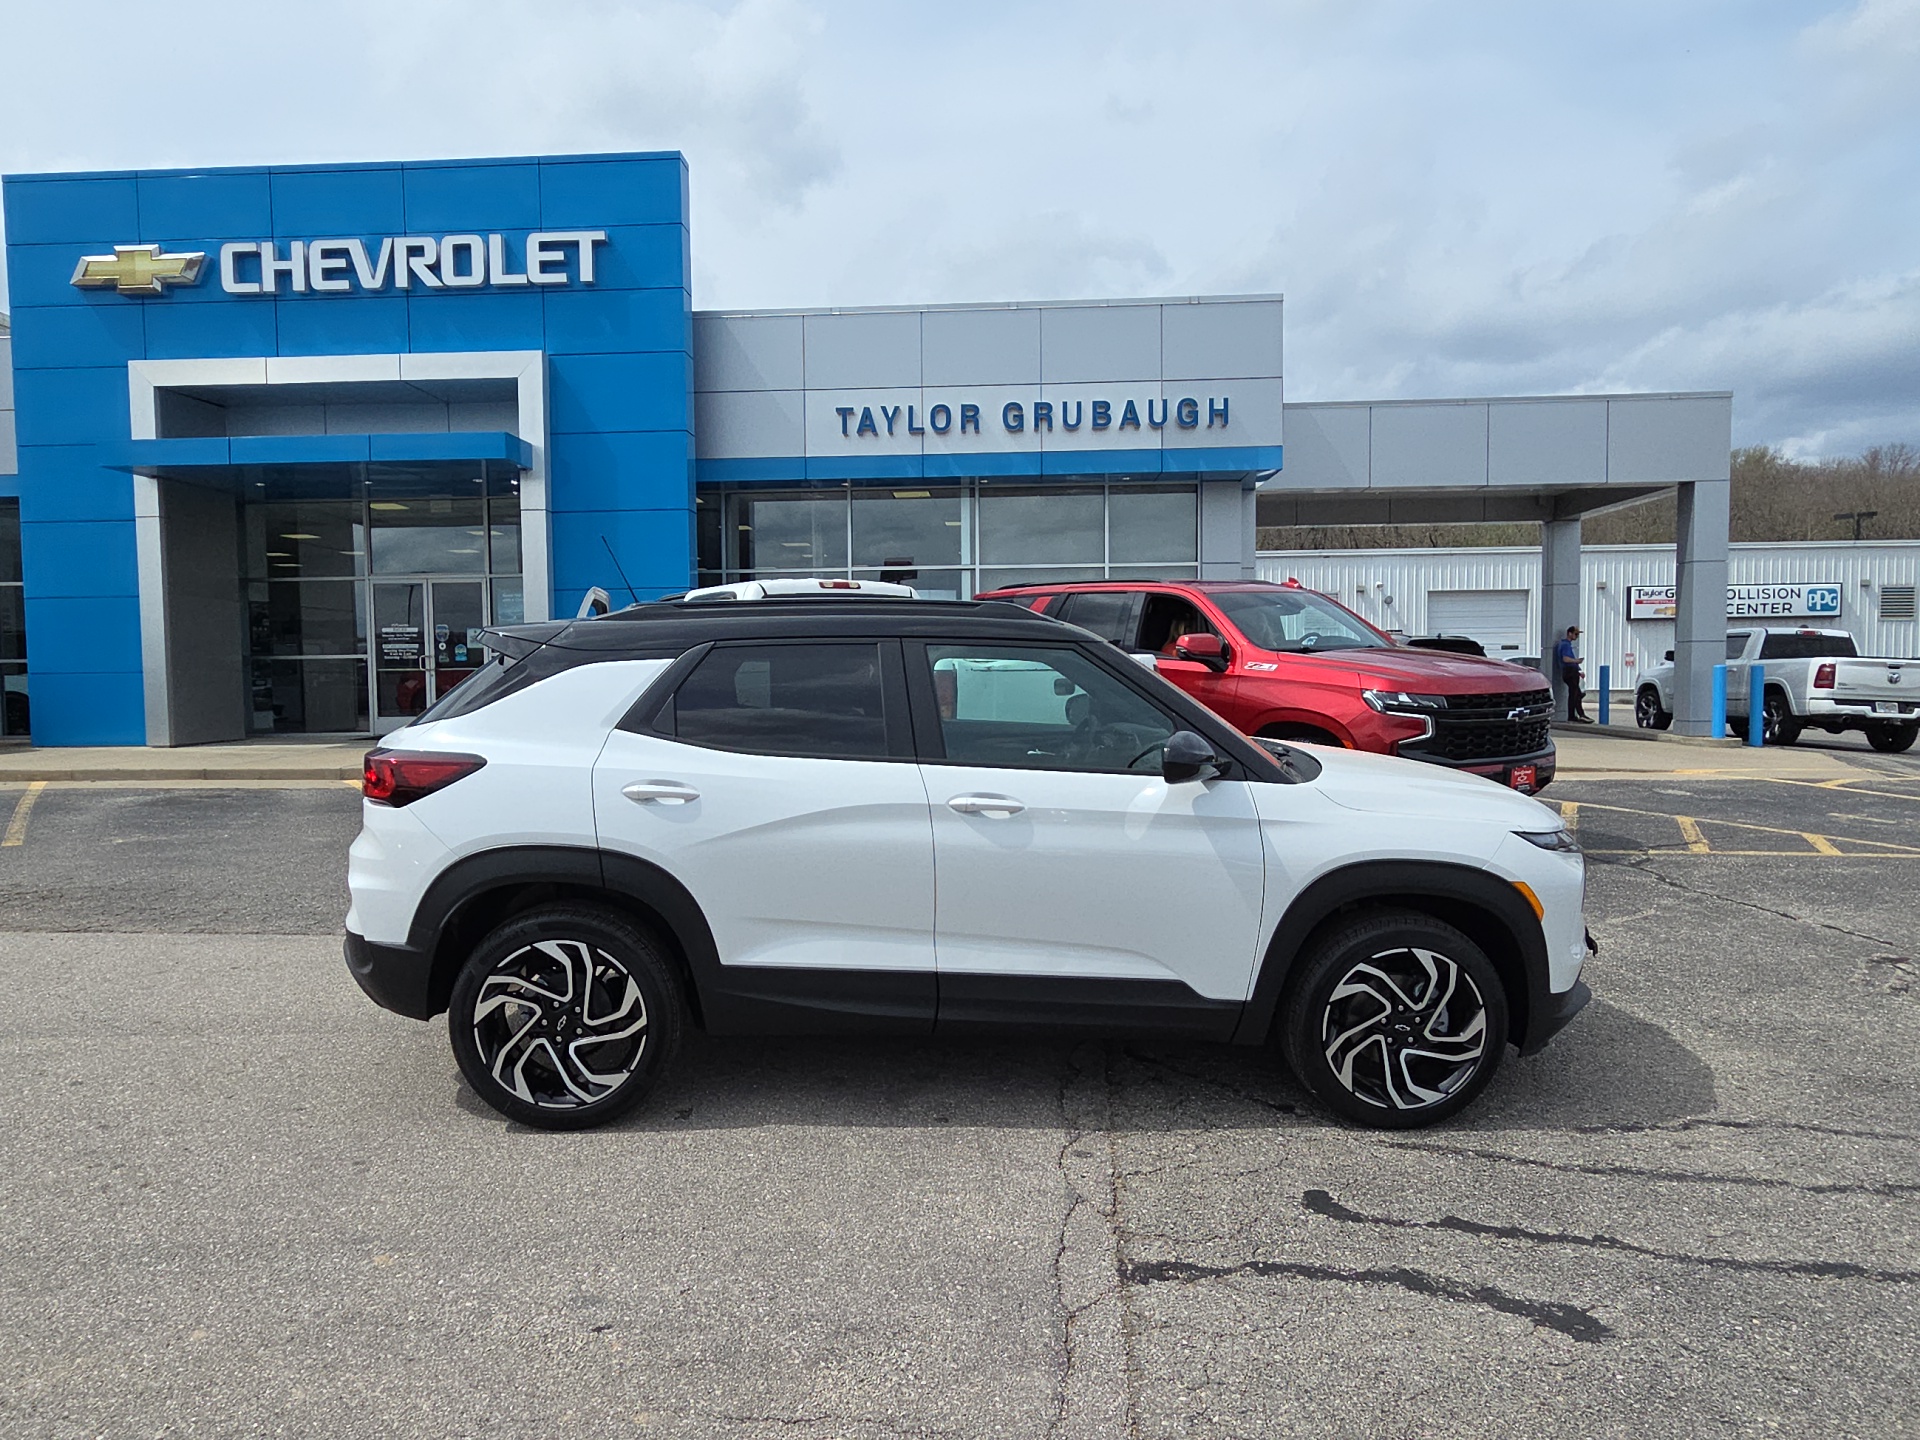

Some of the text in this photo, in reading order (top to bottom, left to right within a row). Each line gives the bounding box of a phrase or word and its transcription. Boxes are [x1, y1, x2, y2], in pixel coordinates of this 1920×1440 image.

[220, 230, 608, 295] CHEVROLET
[835, 397, 1230, 436] TAYLOR GRUBAUGH
[1635, 588, 1664, 600] Taylor
[1726, 587, 1801, 600] OLLISION
[1808, 590, 1837, 611] PPG
[1726, 602, 1793, 615] CENTER
